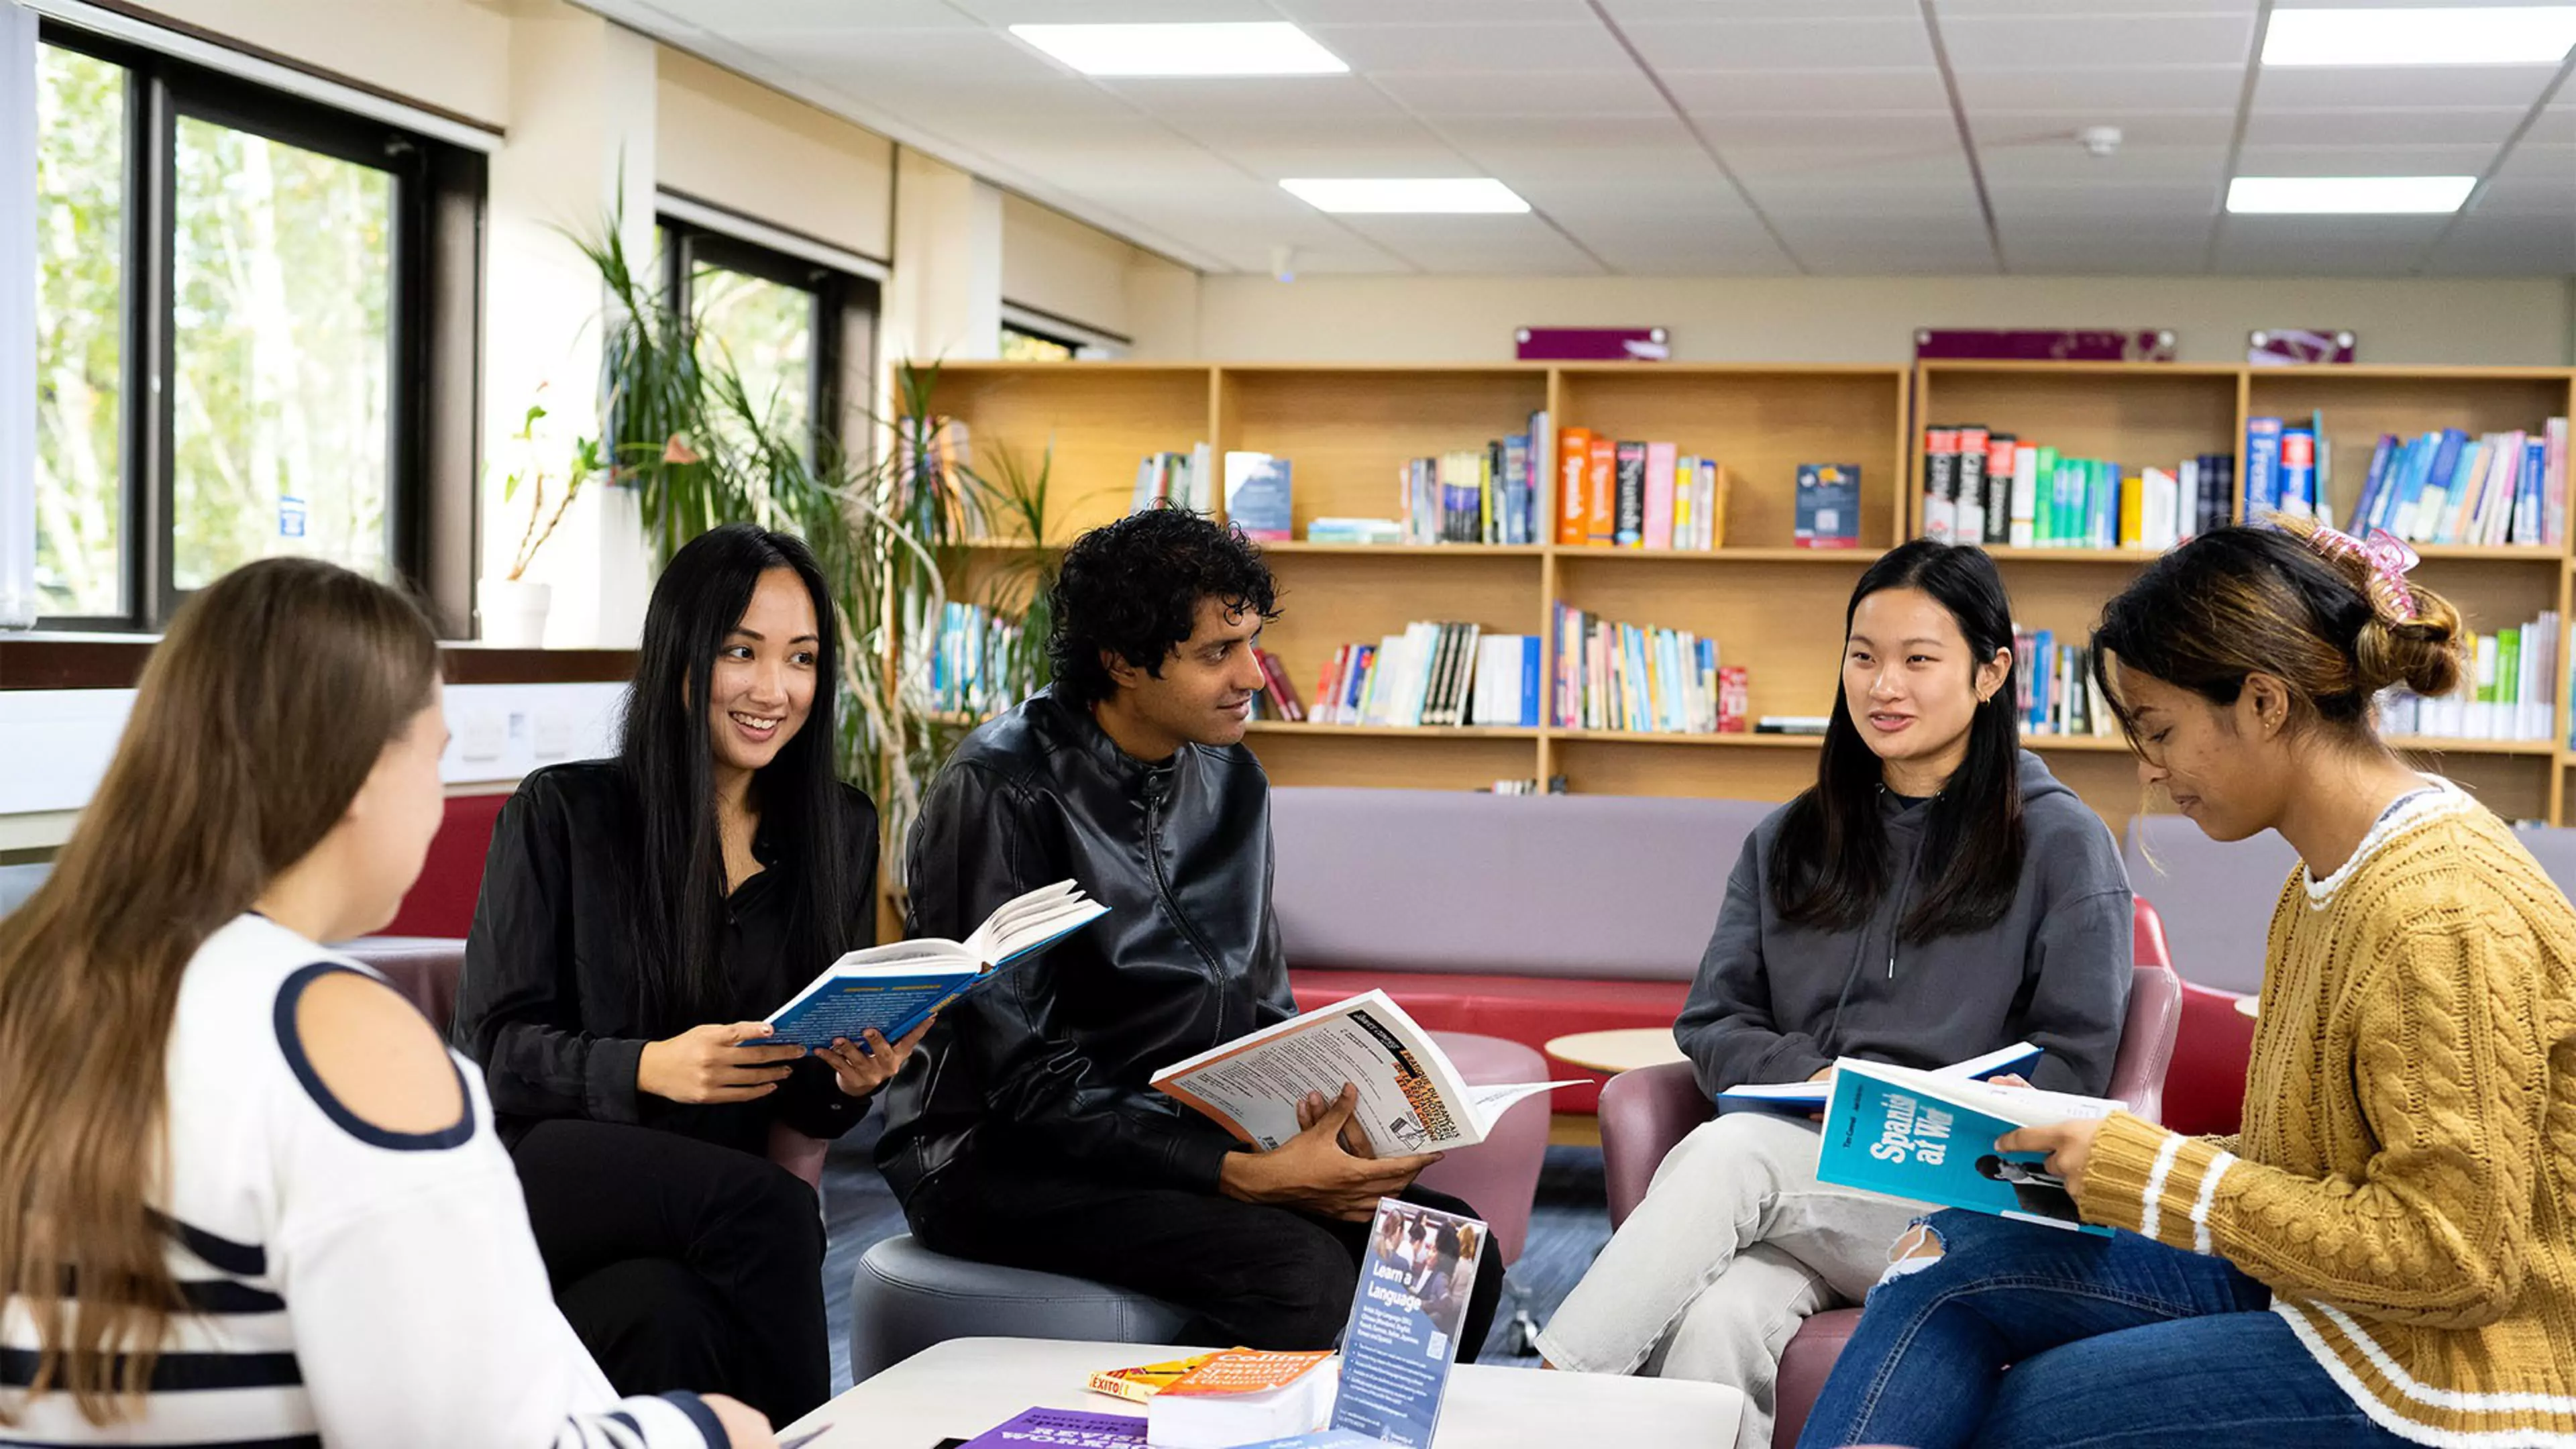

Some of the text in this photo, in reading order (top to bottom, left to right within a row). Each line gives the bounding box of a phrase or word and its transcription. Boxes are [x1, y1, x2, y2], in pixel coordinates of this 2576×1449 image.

[1403, 1051, 1432, 1085] PRATIQUE
[1428, 1087, 1439, 1099] DU
[1870, 1093, 1917, 1164] Spanish
[1913, 1139, 1947, 1165] at
[1373, 1260, 1412, 1285] Learn a
[1367, 1280, 1422, 1313] Language
[1021, 1417, 1120, 1432] Spanish
